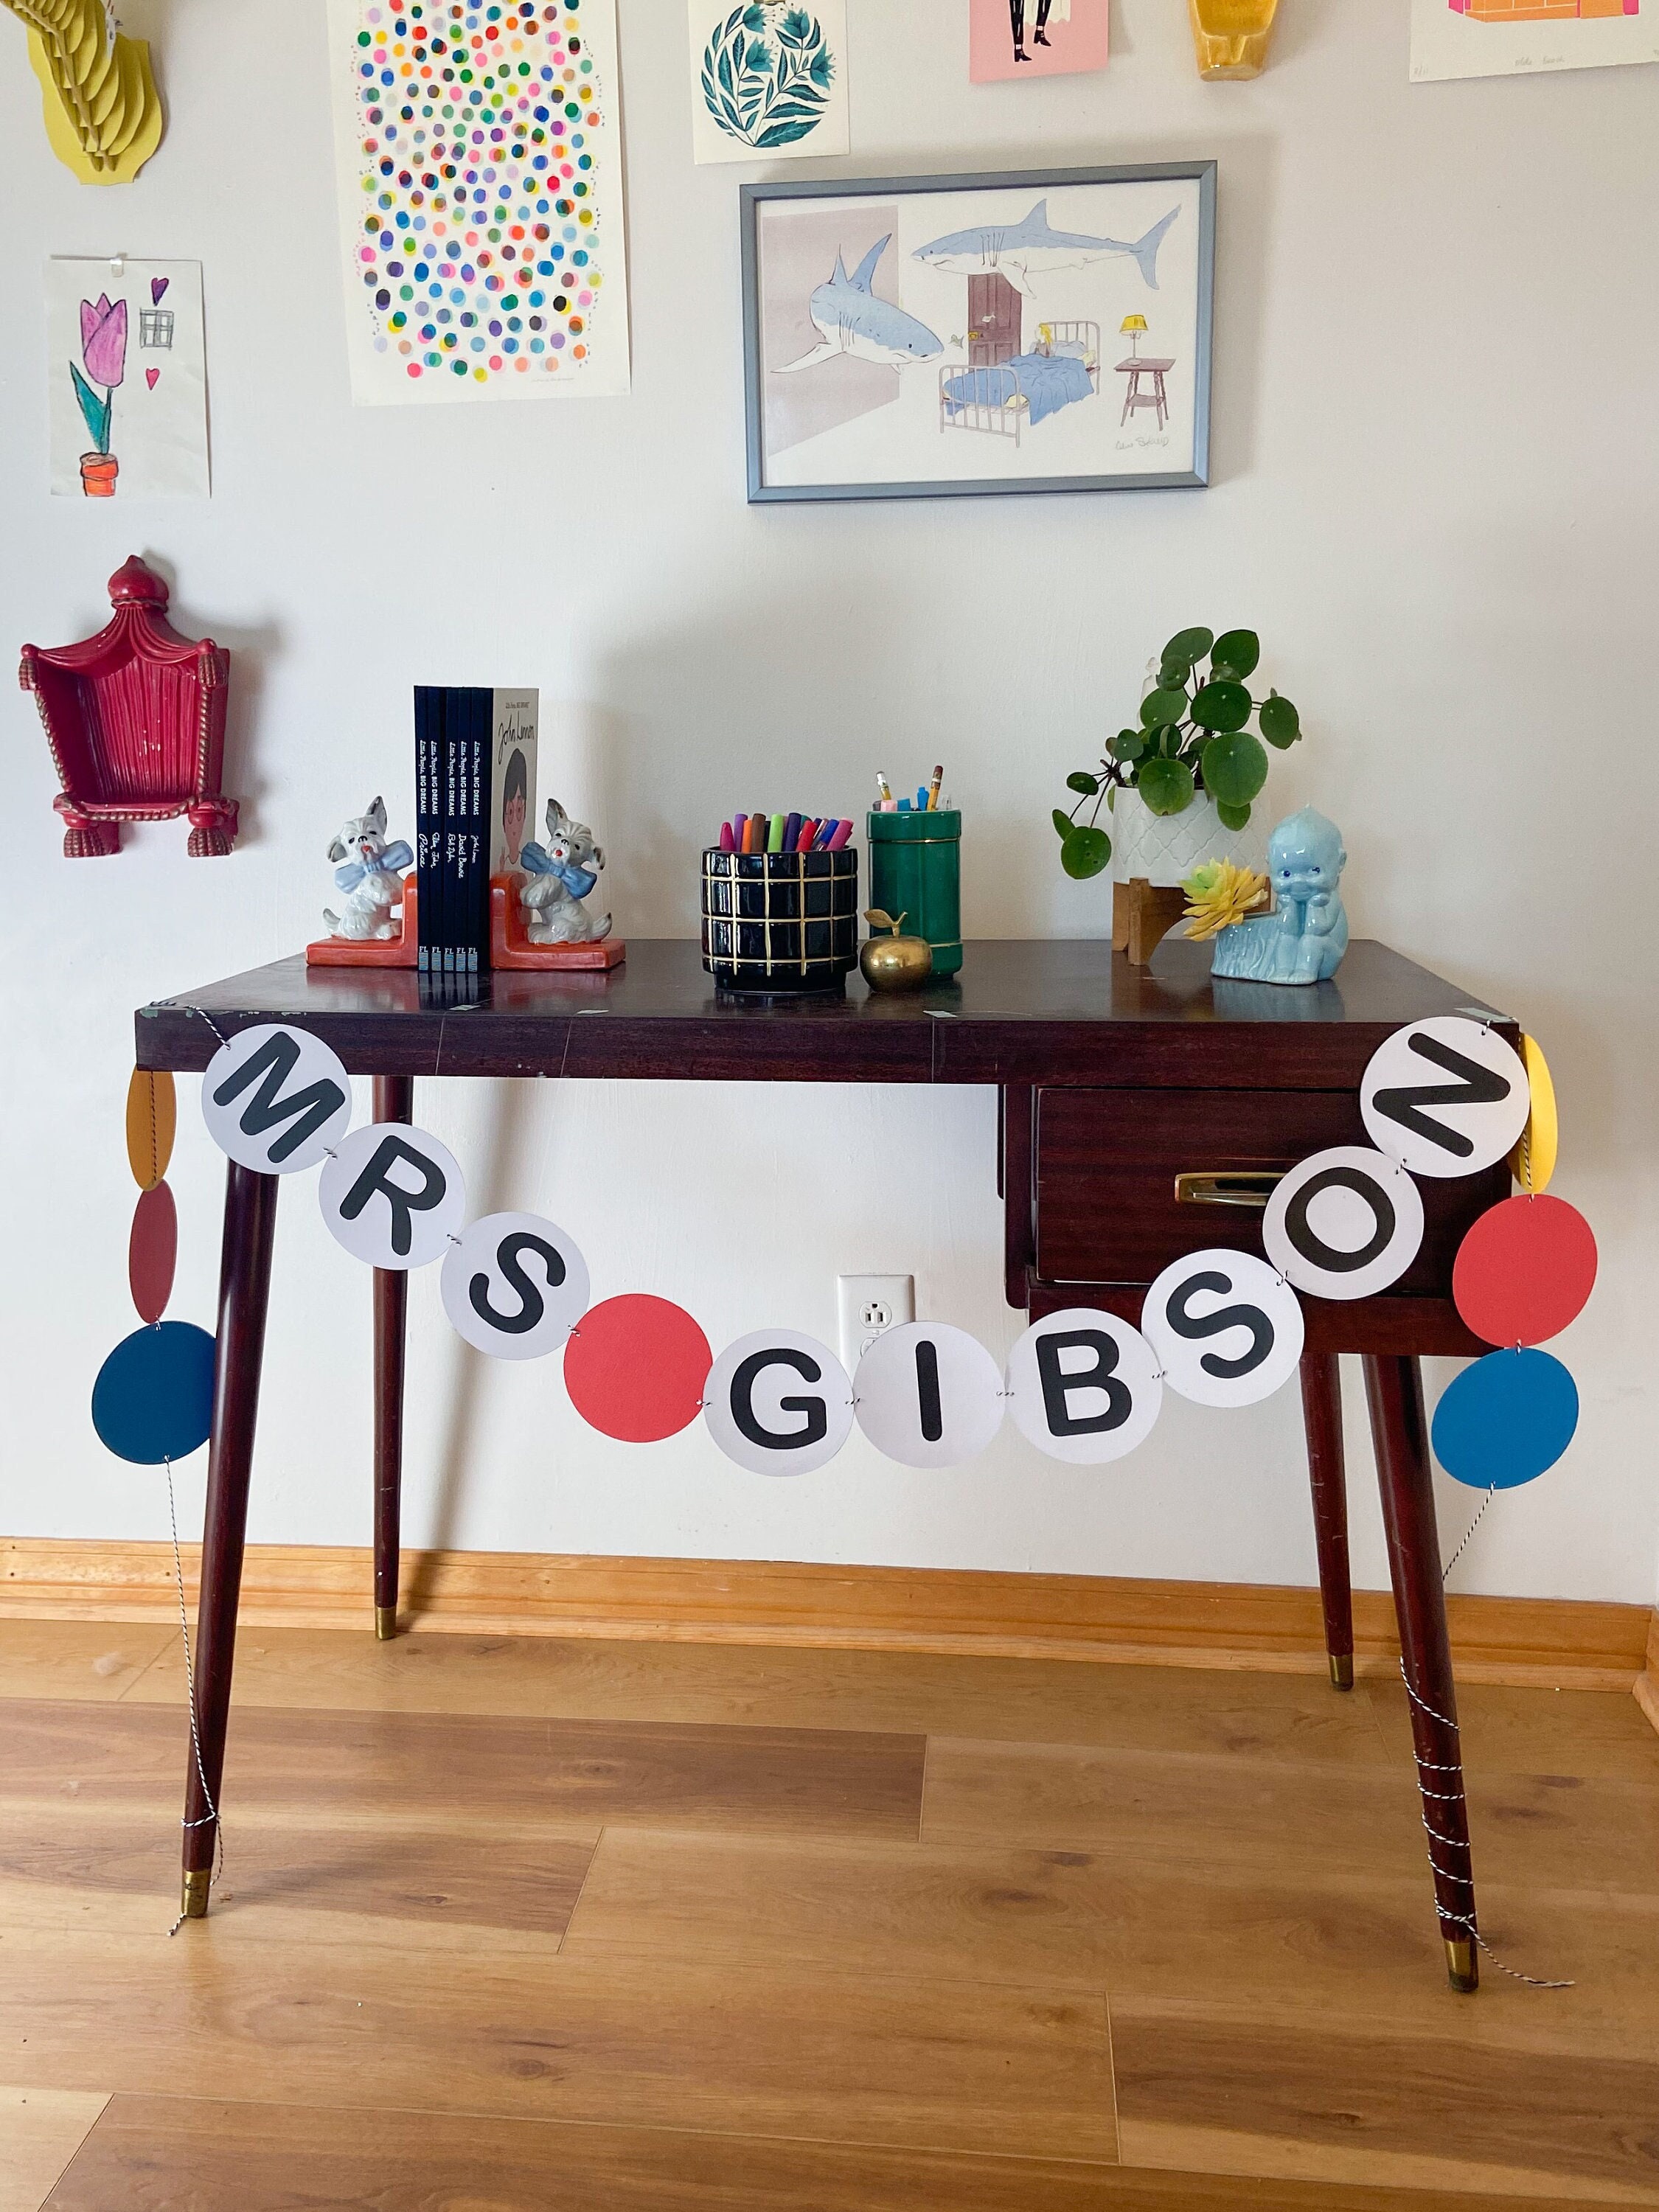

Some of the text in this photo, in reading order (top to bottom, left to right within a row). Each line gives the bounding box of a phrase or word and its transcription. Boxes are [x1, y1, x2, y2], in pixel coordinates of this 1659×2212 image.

[418, 833, 428, 869] Prince
[458, 833, 467, 879] David Bowie
[212, 1031, 567, 1335] MRS
[729, 1032, 1512, 1450] GIBSON
